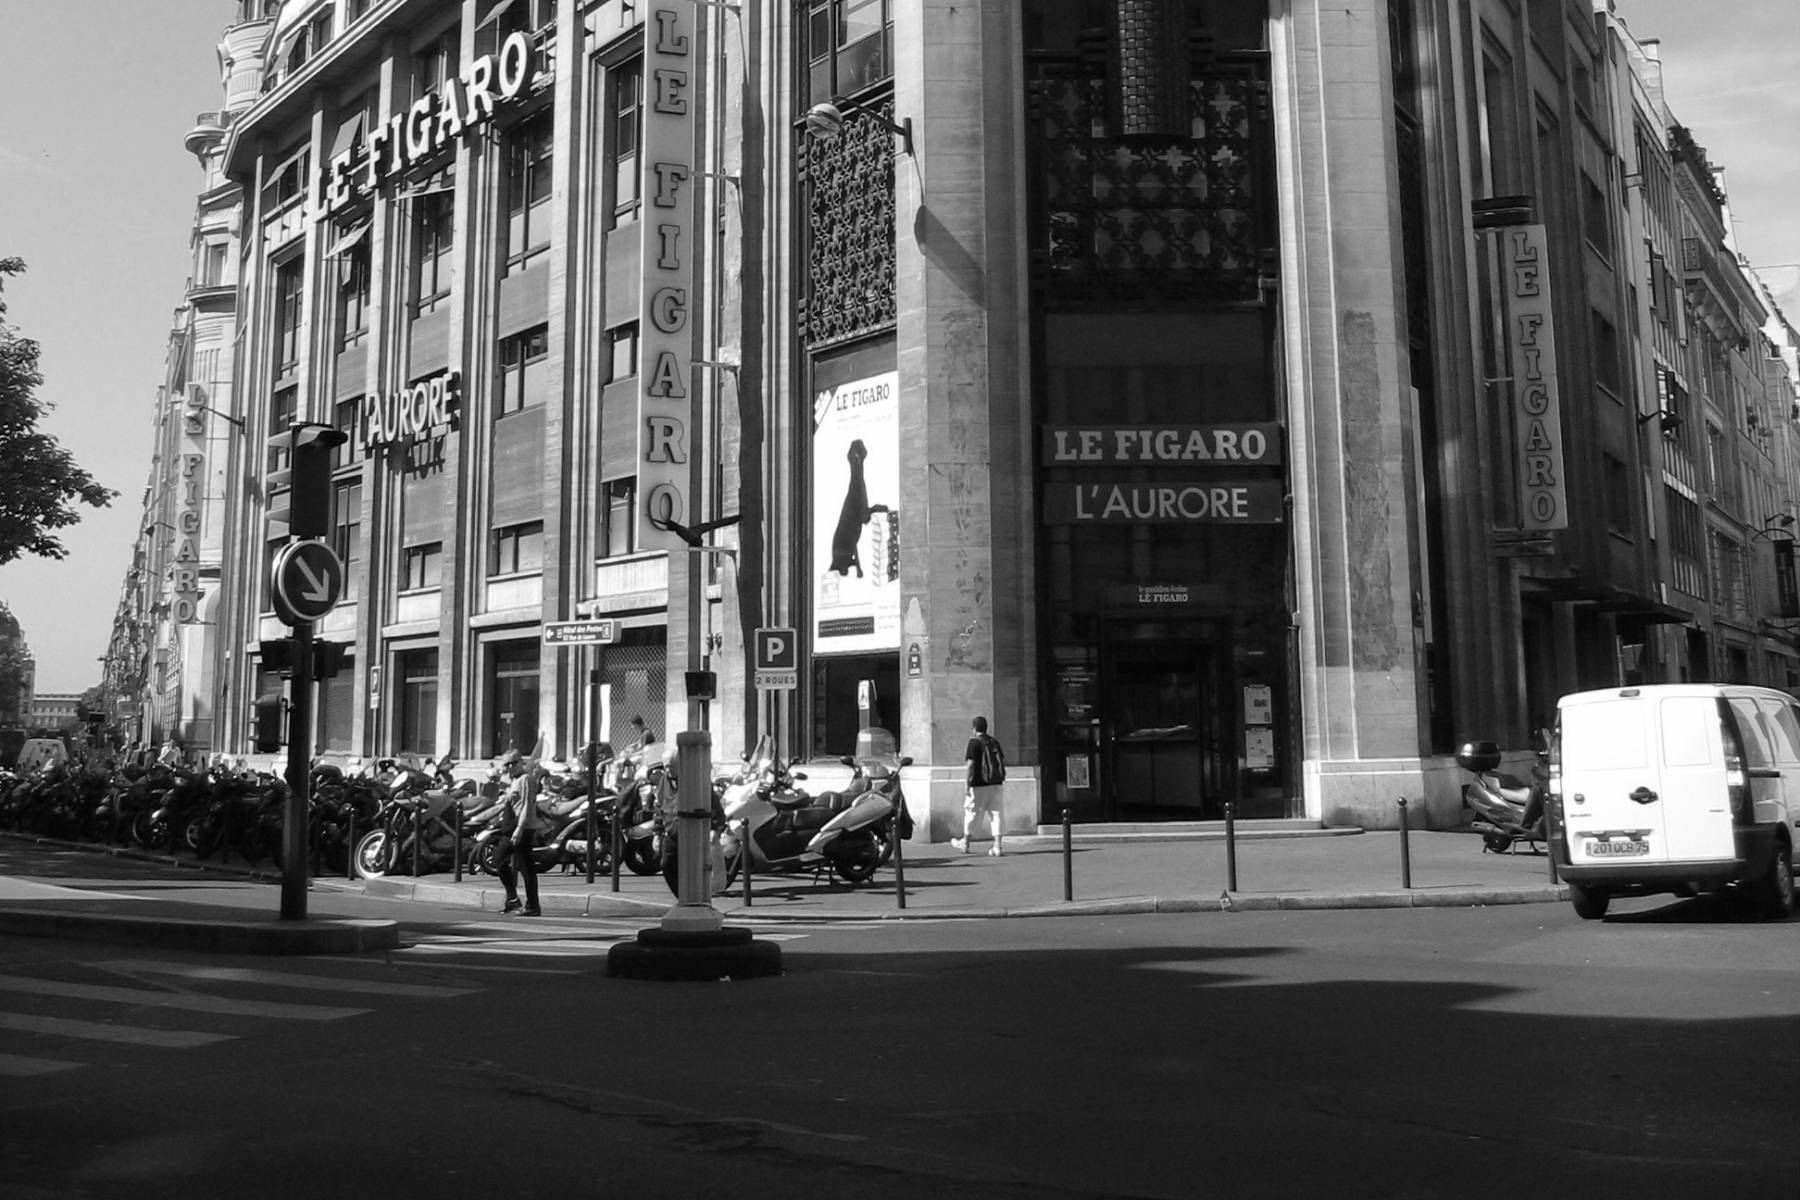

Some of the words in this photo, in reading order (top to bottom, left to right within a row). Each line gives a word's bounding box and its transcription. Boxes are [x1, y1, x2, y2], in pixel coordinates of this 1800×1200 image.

[655, 10, 688, 115] LE
[308, 149, 350, 223] LE
[367, 31, 534, 189] FIGARO
[1512, 232, 1540, 297] LE
[647, 162, 688, 531] FIGARO
[836, 394, 848, 411] LE
[852, 383, 890, 408] FIGARO
[1519, 313, 1556, 523] FIGARO
[1054, 430, 1103, 460] LE
[1114, 429, 1267, 460] FIGARO
[1075, 484, 1249, 519] L'AURORE
[173, 453, 203, 623] FIGARO
[1138, 593, 1152, 603] LE
[1153, 593, 1189, 603] FIGARO
[767, 637, 785, 662] P
[756, 676, 762, 684] 2
[765, 676, 796, 684] ROUES
